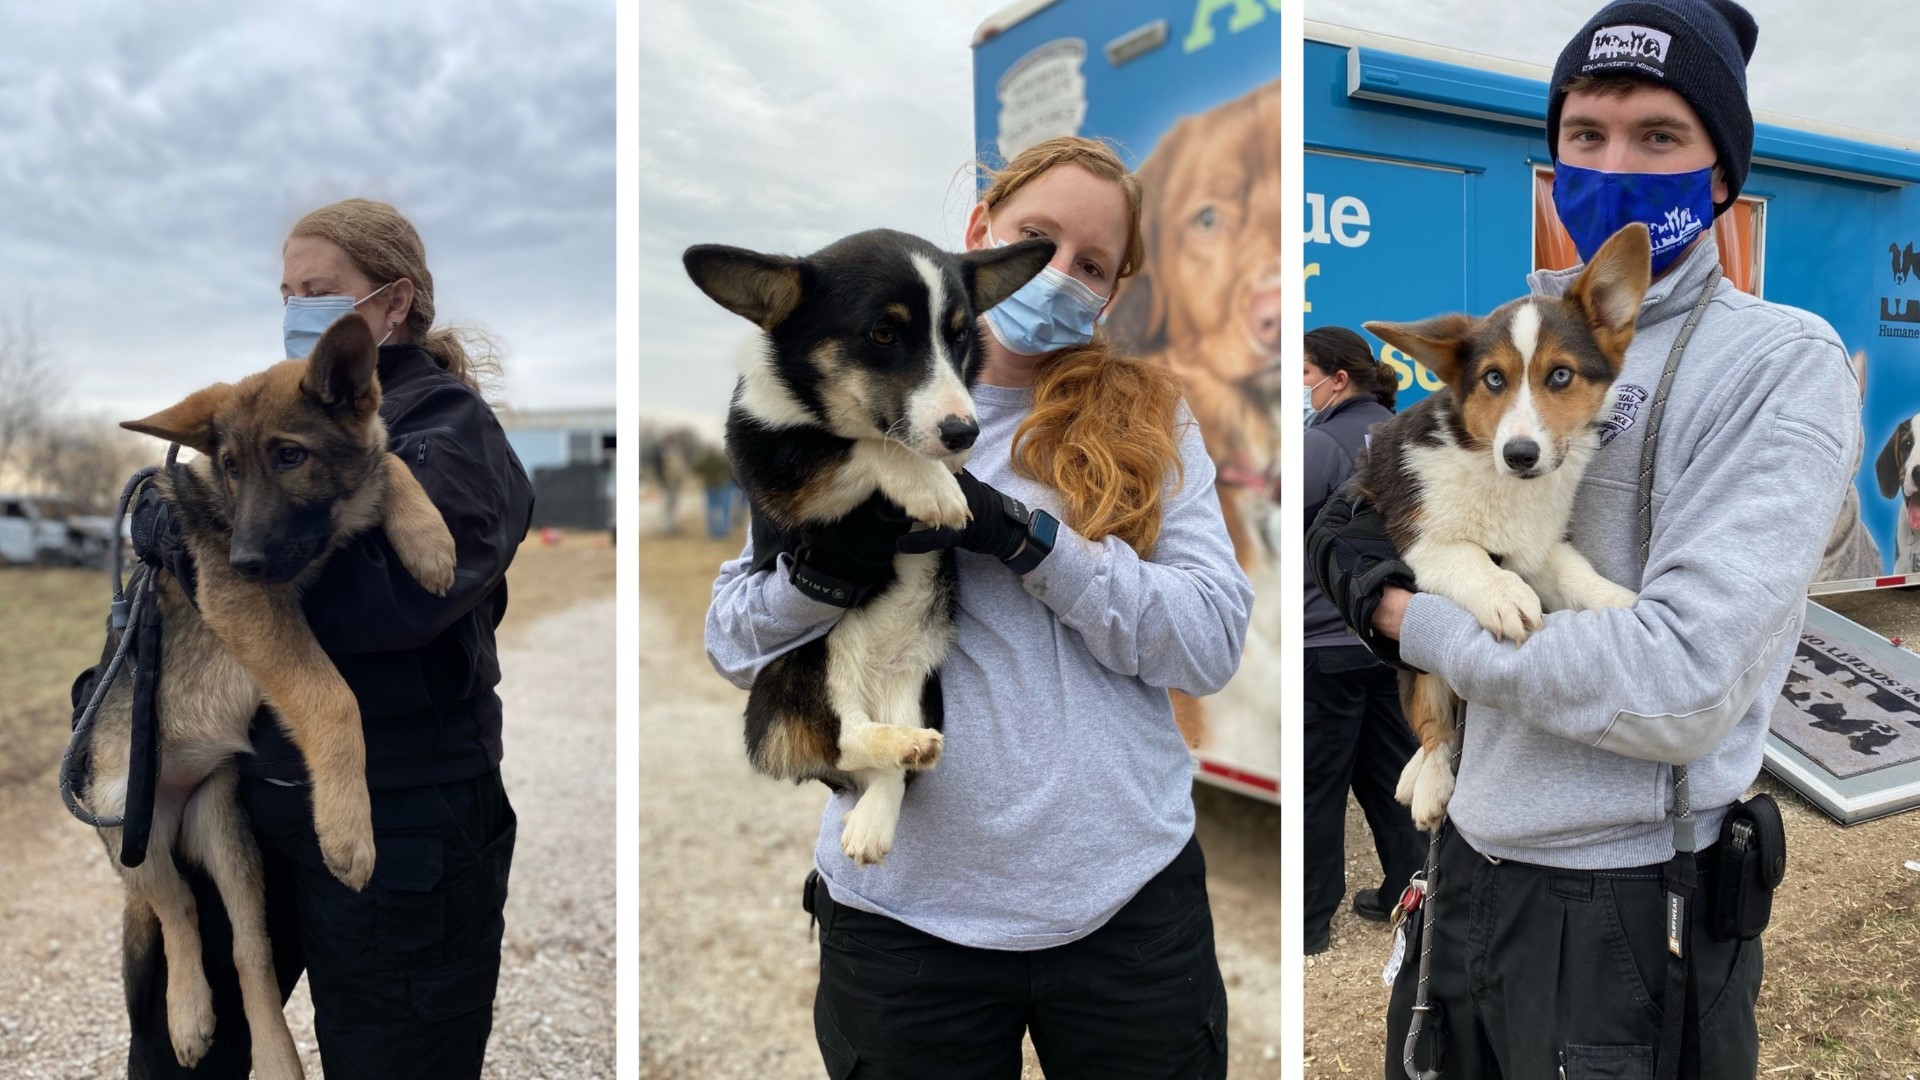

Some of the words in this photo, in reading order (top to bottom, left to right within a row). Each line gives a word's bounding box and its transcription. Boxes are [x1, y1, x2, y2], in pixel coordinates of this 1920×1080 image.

[1879, 325, 1920, 338] Humane
[1610, 414, 1628, 427] ORCE
[796, 573, 831, 594] ARIAT
[1822, 646, 1900, 687] SOCIETY
